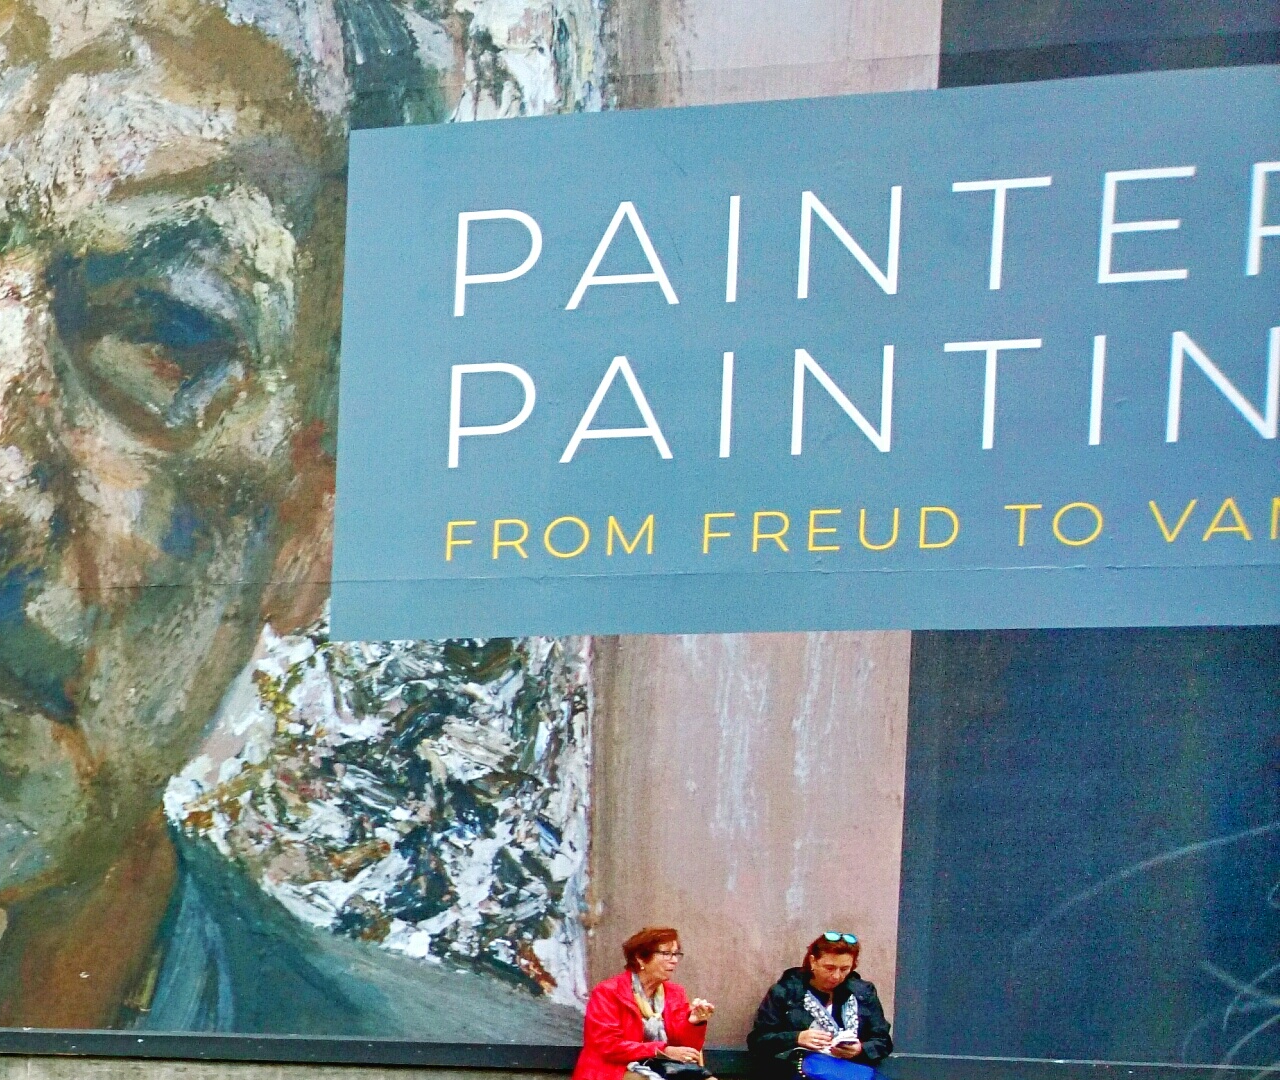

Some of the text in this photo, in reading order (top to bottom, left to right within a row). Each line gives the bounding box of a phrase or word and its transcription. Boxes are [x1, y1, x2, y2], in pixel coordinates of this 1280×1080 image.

[444, 496, 1280, 563] FROM FREUD TO VA
